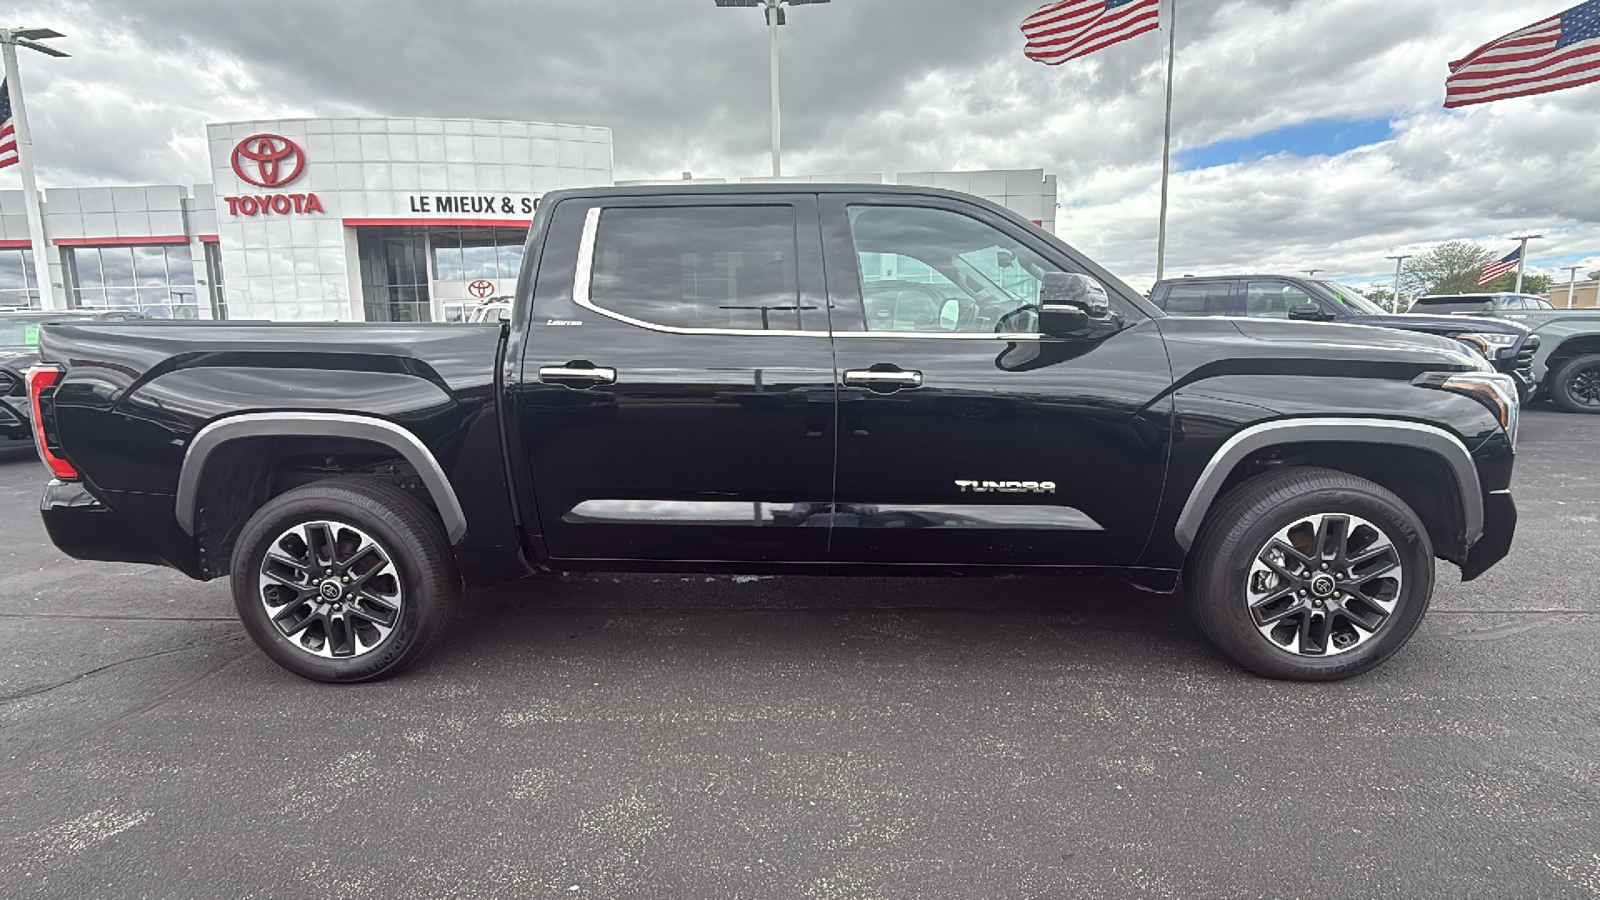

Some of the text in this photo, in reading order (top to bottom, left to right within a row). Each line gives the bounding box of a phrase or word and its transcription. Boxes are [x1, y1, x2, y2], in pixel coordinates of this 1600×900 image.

[224, 193, 324, 216] TOYOTA
[410, 196, 431, 213] LE
[435, 196, 497, 214] MIEUX
[501, 197, 516, 214] &
[954, 480, 1056, 493] TUNDRA
[1360, 498, 1416, 544] OKOHAMA
